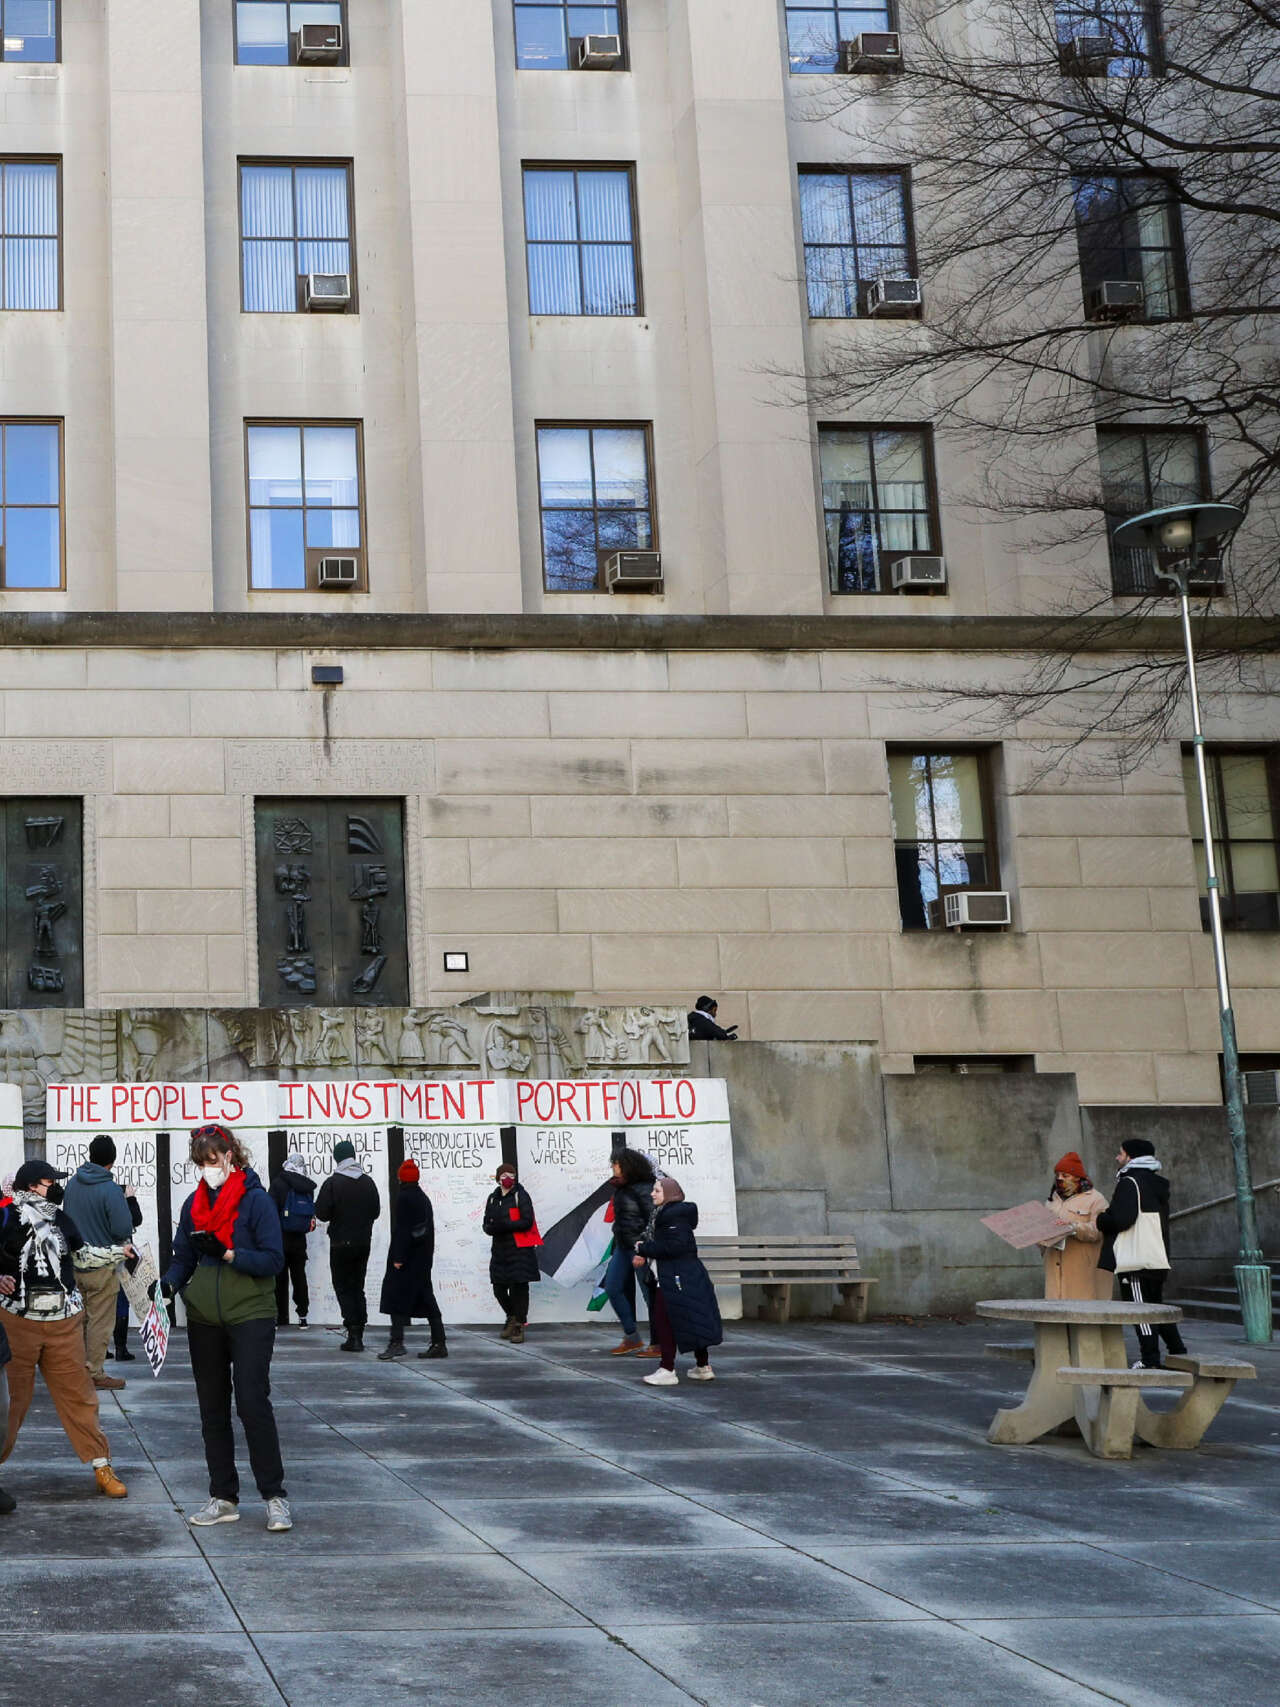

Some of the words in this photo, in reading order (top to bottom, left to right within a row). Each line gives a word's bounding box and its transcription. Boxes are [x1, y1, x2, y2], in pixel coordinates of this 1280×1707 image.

[47, 1085, 101, 1122] THE
[112, 1084, 243, 1122] PEOPLES
[279, 1081, 495, 1120] INVSTMENT
[517, 1080, 696, 1122] PORTFOLIO
[404, 1131, 496, 1151] REPRODUCTIVE
[536, 1130, 574, 1150] FAIR
[647, 1129, 689, 1148] HOME
[123, 1141, 156, 1165] AND
[410, 1148, 483, 1170] SERVICES
[530, 1149, 577, 1165] WAGES
[141, 1319, 163, 1371] NOW
